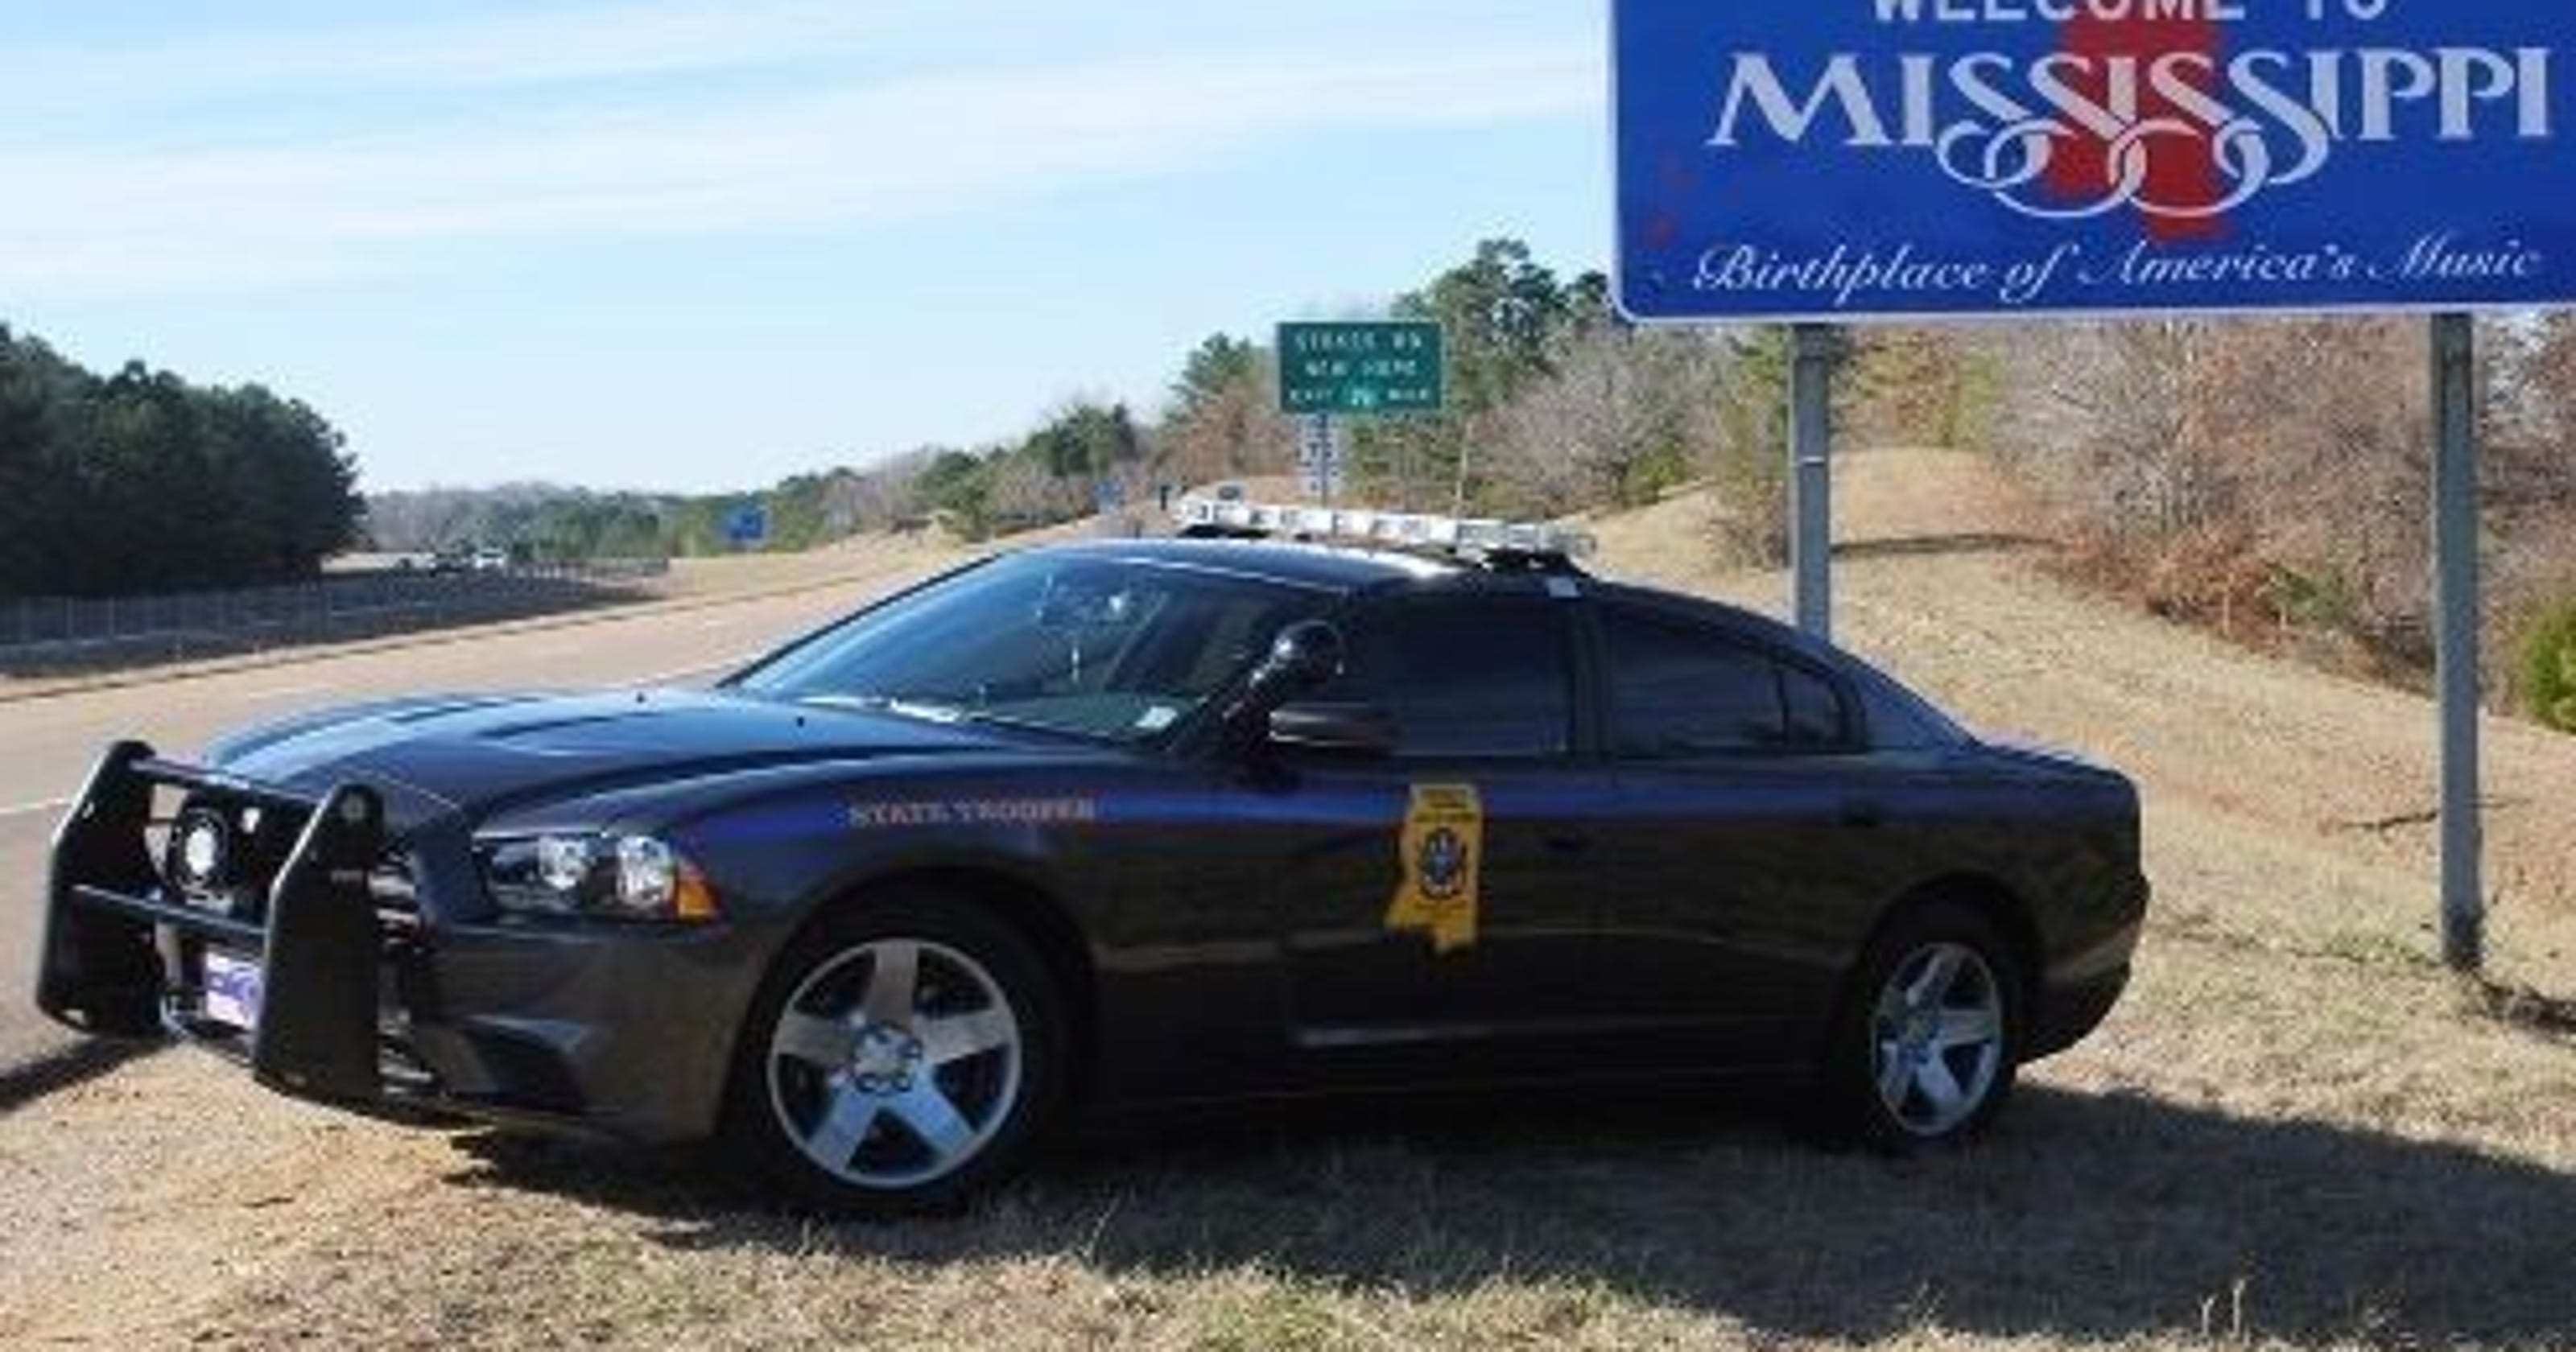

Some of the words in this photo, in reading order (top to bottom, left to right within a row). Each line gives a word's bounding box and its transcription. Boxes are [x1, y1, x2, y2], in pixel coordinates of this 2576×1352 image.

[1707, 47, 2552, 217] MISSISSIPPI
[1694, 243, 1990, 307] Birthplace
[1998, 243, 2080, 303] of
[2076, 240, 2354, 285] America's
[2368, 233, 2541, 280] Music
[848, 800, 951, 826] STATE
[952, 796, 1096, 821] TROOPER
